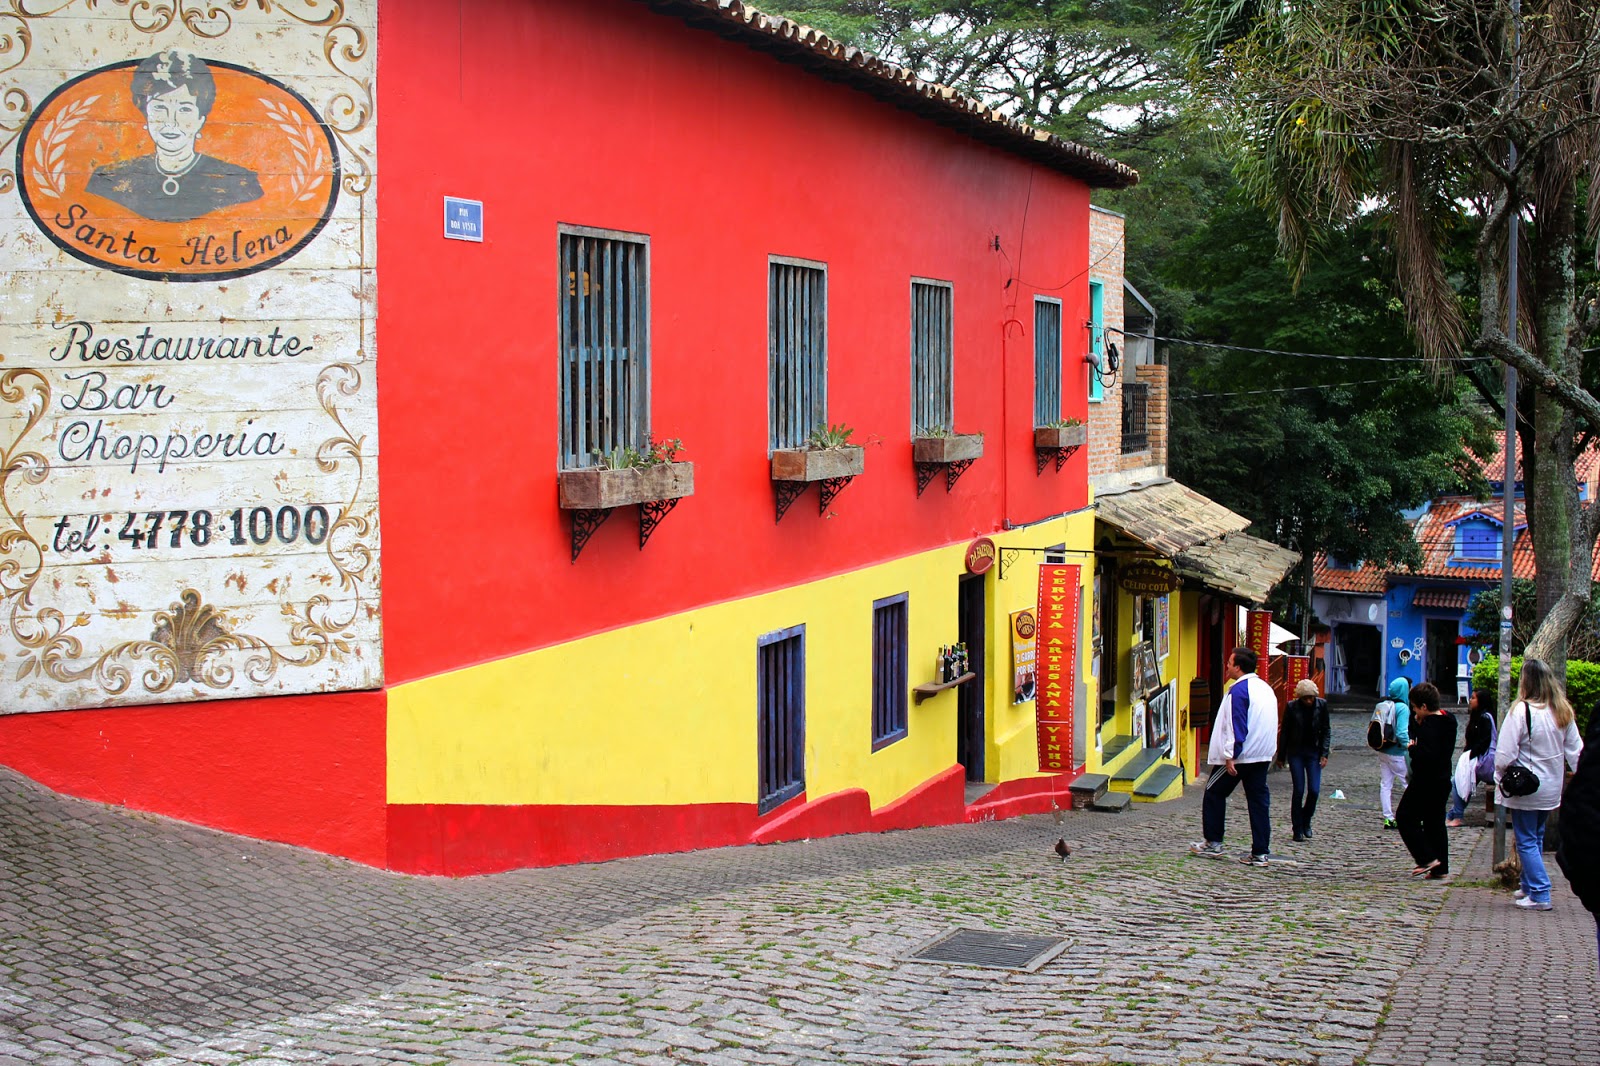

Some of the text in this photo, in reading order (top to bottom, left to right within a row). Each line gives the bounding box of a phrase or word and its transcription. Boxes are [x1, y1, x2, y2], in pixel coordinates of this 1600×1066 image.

[55, 203, 293, 266] Santa Helena
[450, 219, 477, 232] BOA VISTA
[50, 320, 313, 362] Restaurante
[60, 371, 175, 411] Bar
[1148, 583, 1170, 592] COTA
[1046, 568, 1067, 717] CERVEJA ARTESANAL
[1046, 726, 1062, 769] VINHO
